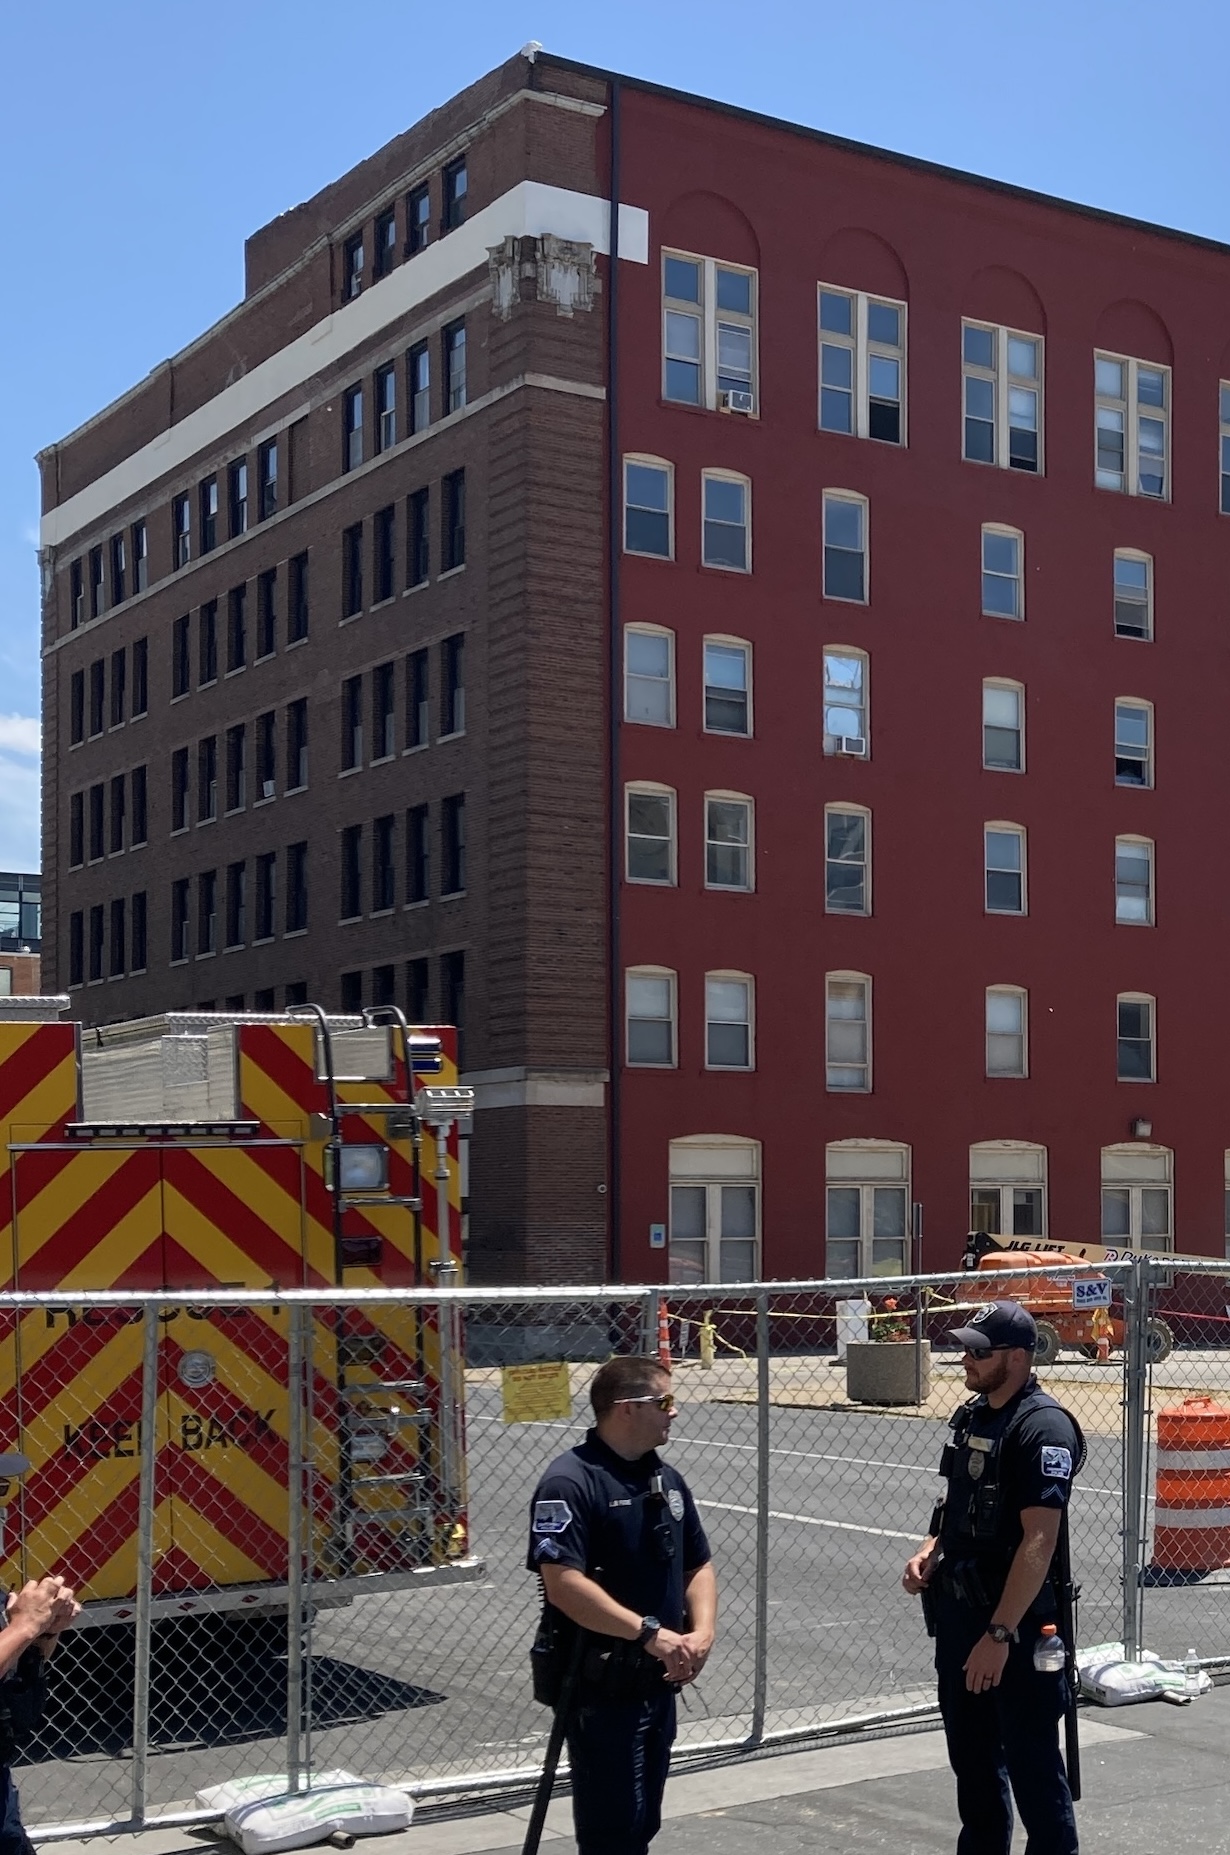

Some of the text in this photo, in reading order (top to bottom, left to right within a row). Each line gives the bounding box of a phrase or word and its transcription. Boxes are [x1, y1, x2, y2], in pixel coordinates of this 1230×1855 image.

[1005, 1240, 1066, 1253] JLG LIFT
[1076, 1283, 1108, 1297] S&V
[181, 1408, 278, 1452] BACK
